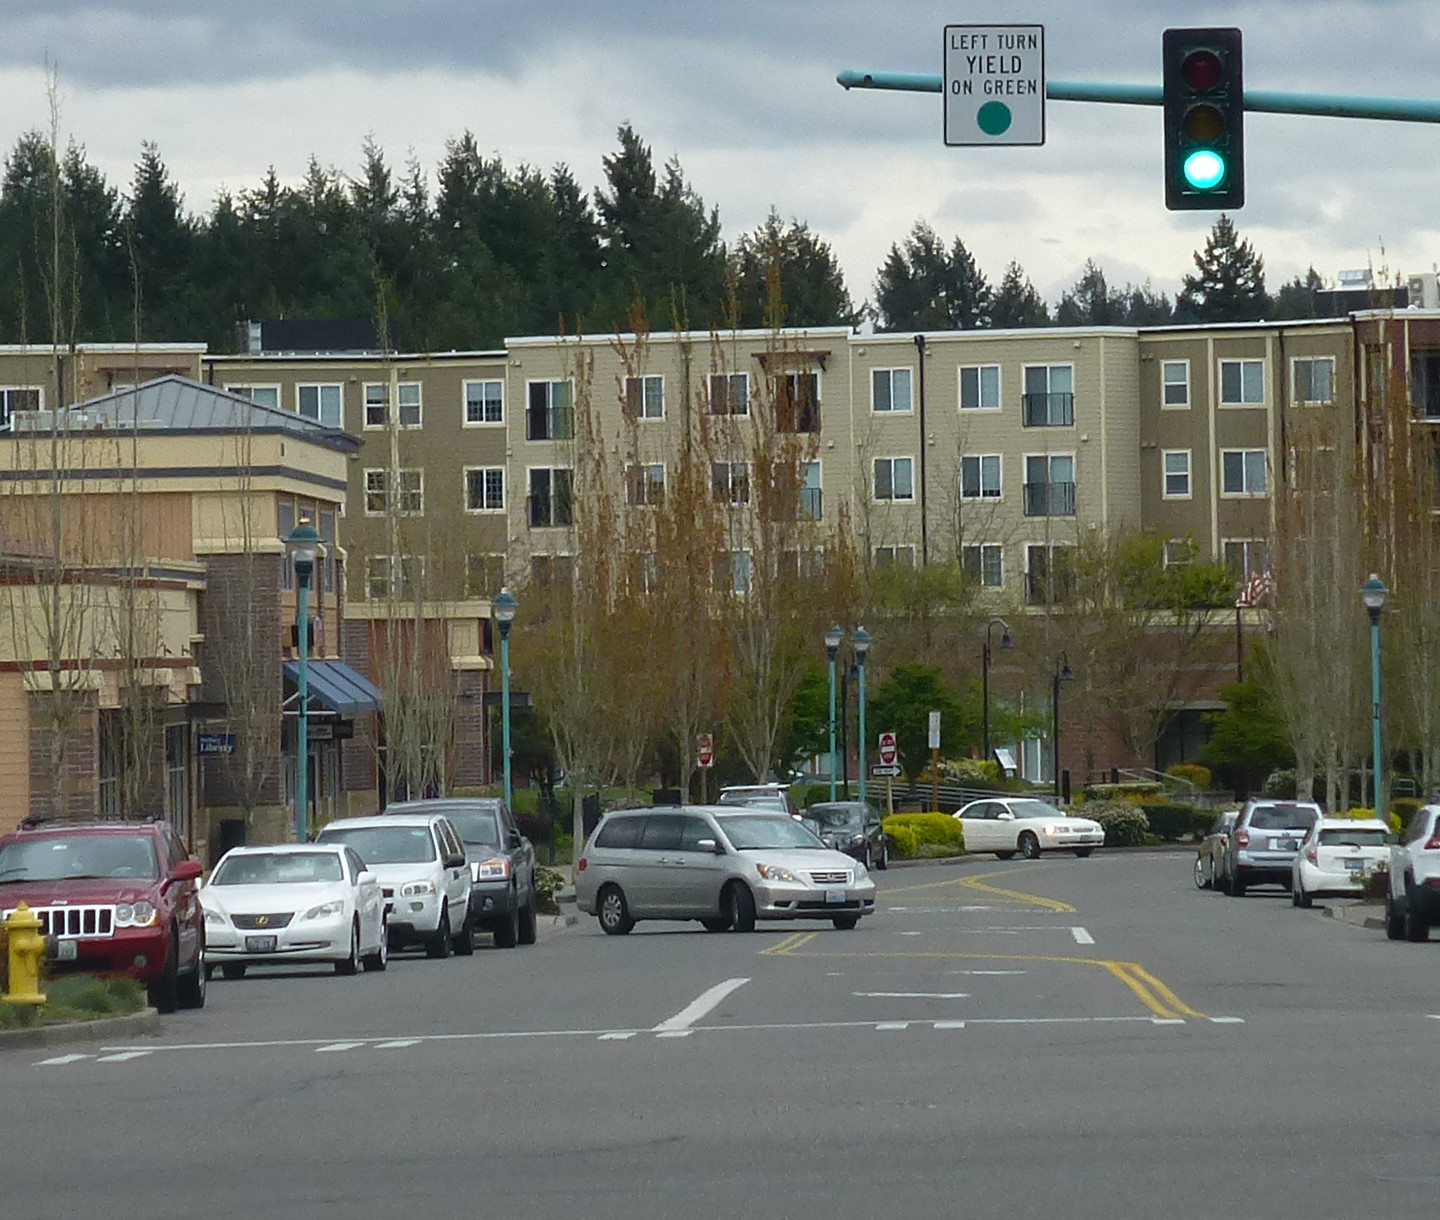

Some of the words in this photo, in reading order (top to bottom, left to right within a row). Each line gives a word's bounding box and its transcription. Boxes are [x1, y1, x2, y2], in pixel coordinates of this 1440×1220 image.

[951, 34, 988, 50] LEFT
[997, 34, 1037, 50] TURN
[966, 55, 1022, 74] YIELD
[951, 79, 972, 95] ON
[983, 79, 1037, 95] GREEN
